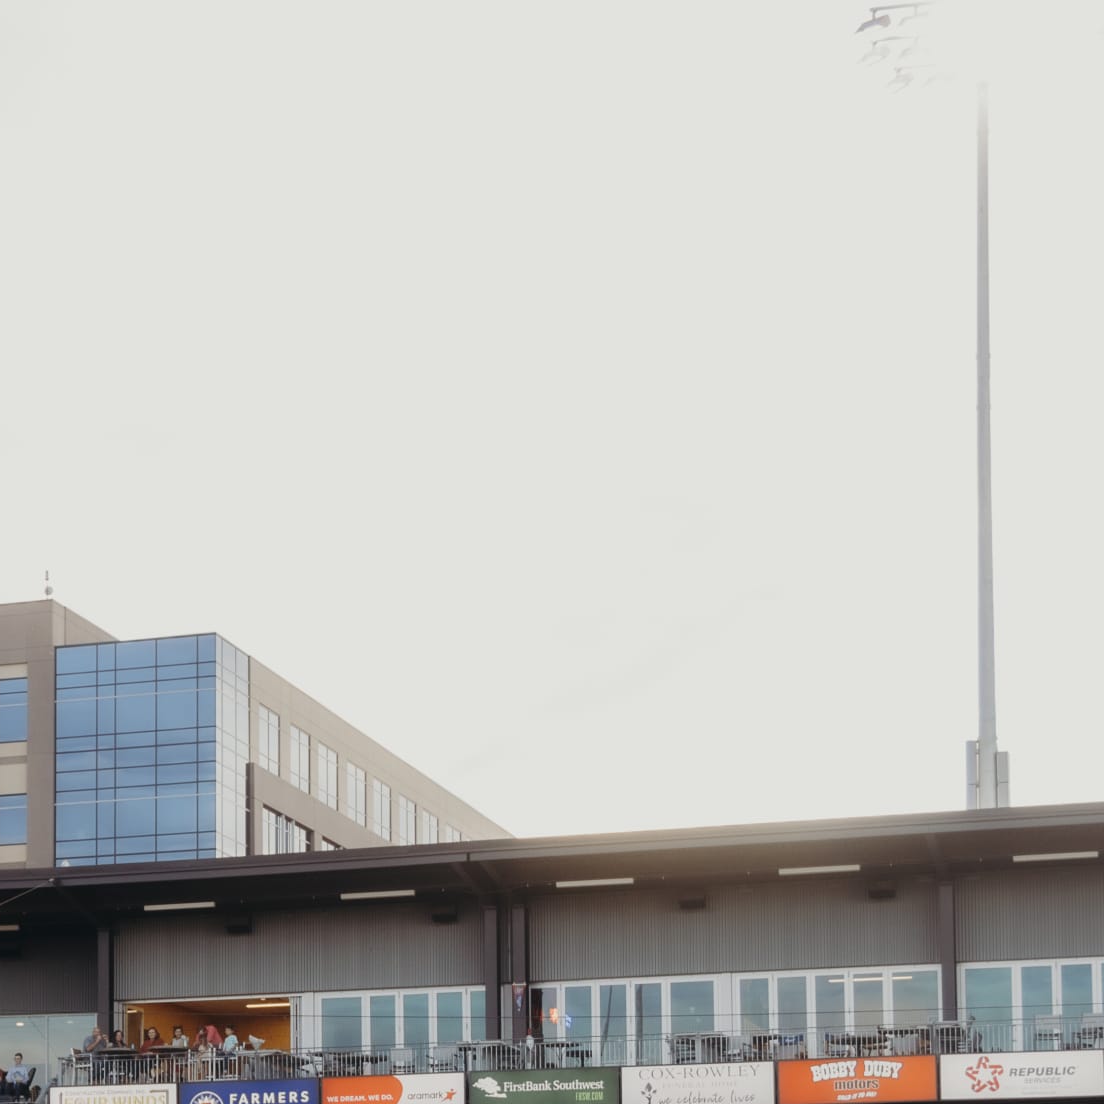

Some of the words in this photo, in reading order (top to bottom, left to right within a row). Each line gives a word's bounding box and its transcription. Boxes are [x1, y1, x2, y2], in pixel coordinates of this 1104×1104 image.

[638, 1064, 760, 1081] COX-ROWLEY
[810, 1060, 857, 1082] BOBBY
[863, 1060, 903, 1079] DUBY
[1009, 1066, 1076, 1077] REPUBLIC
[503, 1080, 553, 1093] FirstBank
[552, 1079, 604, 1091] Southwest
[834, 1079, 879, 1091] motors
[229, 1090, 310, 1104] FARMERS
[326, 1095, 339, 1103] WE
[407, 1090, 443, 1100] aramark
[659, 1097, 672, 1104] we
[677, 1092, 724, 1104] celebrate
[730, 1089, 755, 1103] lives
